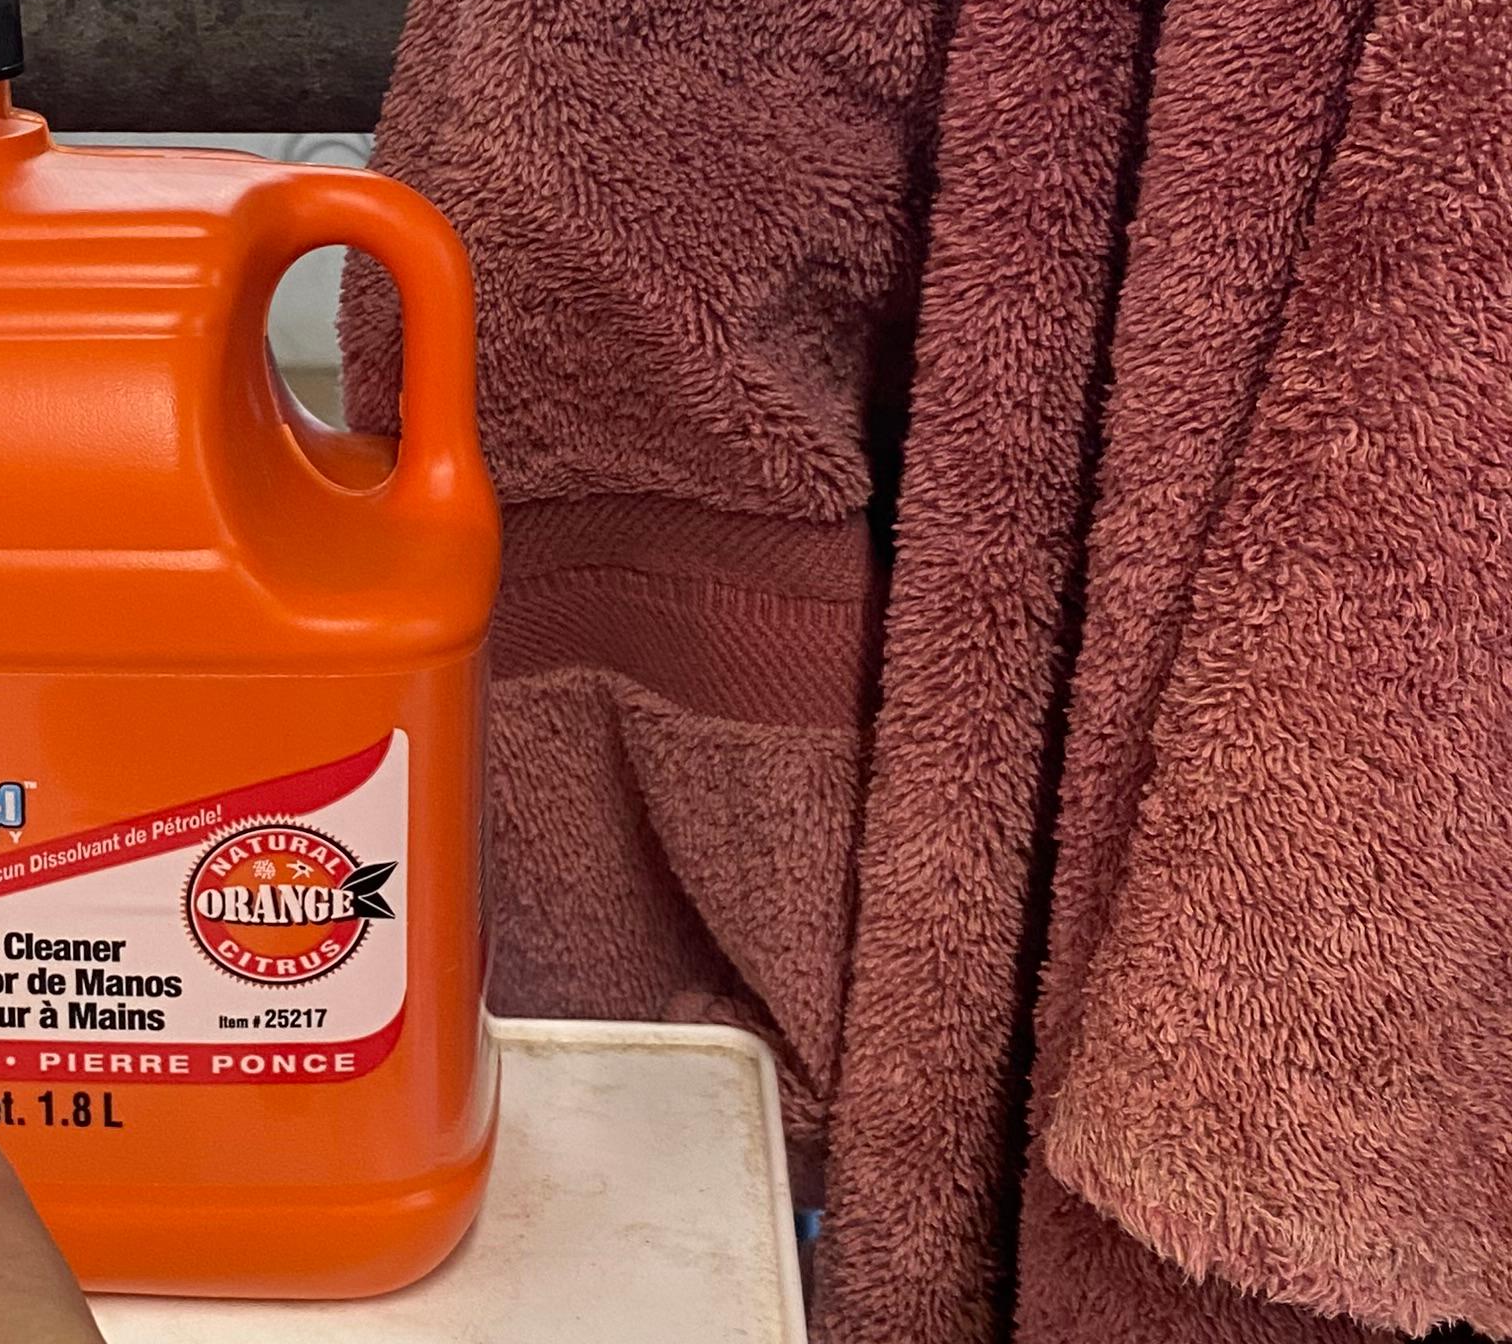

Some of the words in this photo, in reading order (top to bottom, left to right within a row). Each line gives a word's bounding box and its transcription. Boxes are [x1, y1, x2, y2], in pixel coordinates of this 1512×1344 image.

[29, 833, 121, 873] Dissolvant
[123, 827, 148, 846] de
[151, 804, 223, 841] Pétrole!
[209, 834, 342, 877] NATURAL
[196, 883, 356, 925] ORANGE
[3, 931, 127, 963] Cleaner
[217, 938, 343, 976] CITRUS
[26, 967, 67, 996] de
[74, 968, 183, 999] Manos
[39, 1001, 59, 1030] à
[67, 1001, 166, 1032] Mains
[218, 1015, 249, 1029] Item
[252, 1015, 262, 1028] #
[264, 1008, 328, 1029] 25217
[39, 1052, 190, 1075] PIERRE
[211, 1052, 357, 1076] PONCE
[37, 1089, 92, 1127] 1.8
[102, 1091, 124, 1129] L
